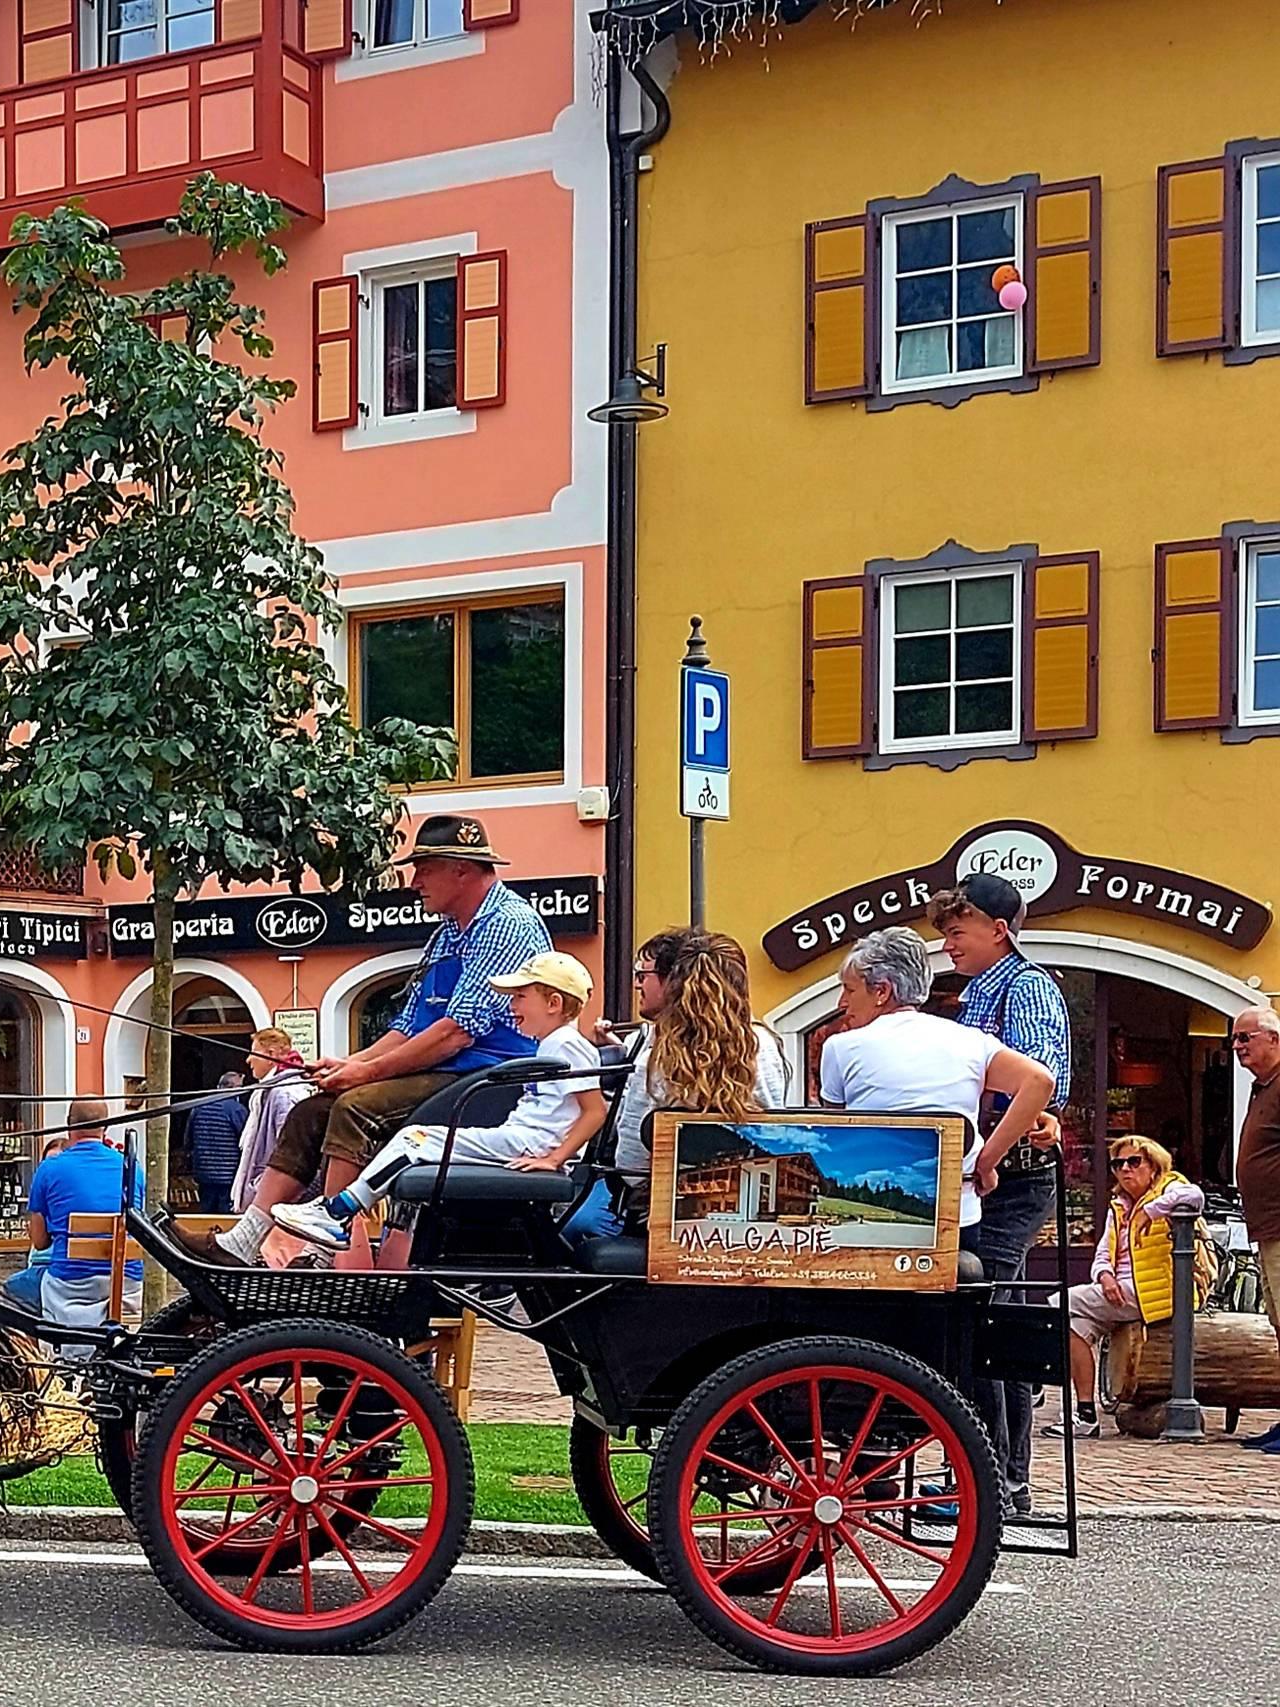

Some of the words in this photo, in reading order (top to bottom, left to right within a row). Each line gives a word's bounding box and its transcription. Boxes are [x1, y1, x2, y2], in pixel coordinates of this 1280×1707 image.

[695, 682, 722, 755] P
[970, 847, 1043, 875] Eder
[112, 913, 235, 944] Graperia
[262, 907, 320, 938] Eder
[529, 889, 590, 917] iche
[792, 877, 932, 950] Speck
[1076, 864, 1244, 935] Formai
[21, 917, 81, 946] Tipici
[677, 1224, 787, 1254] MALGA
